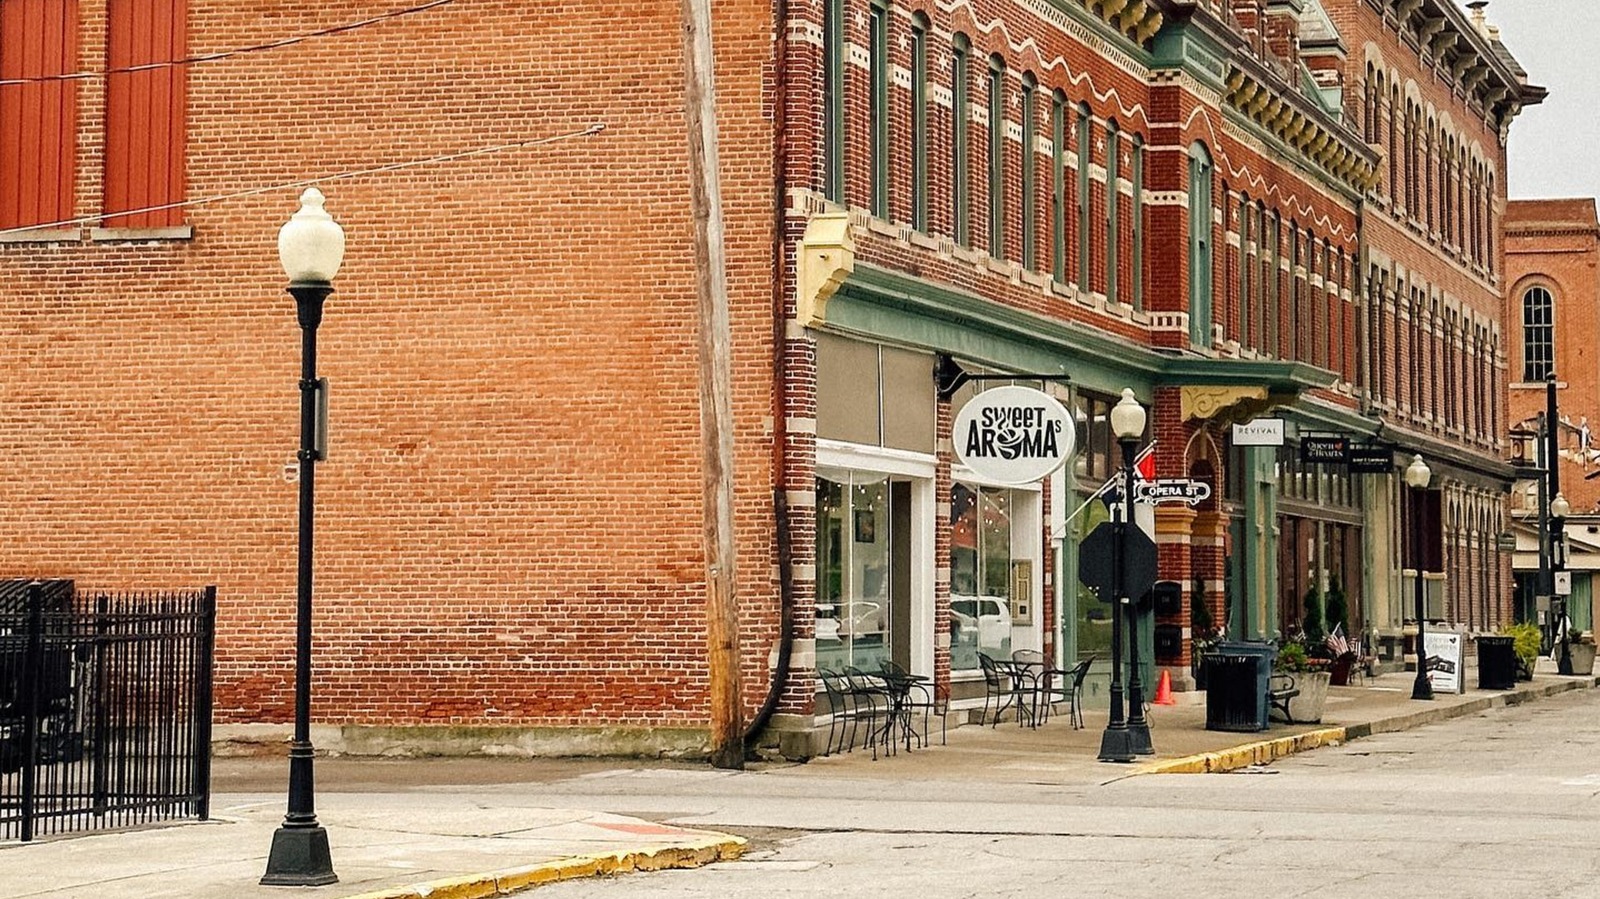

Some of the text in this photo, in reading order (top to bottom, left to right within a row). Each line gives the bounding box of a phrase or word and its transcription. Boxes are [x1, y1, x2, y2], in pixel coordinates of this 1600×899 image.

[1307, 441, 1334, 451] Queen
[1148, 487, 1199, 496] OPERA ST
